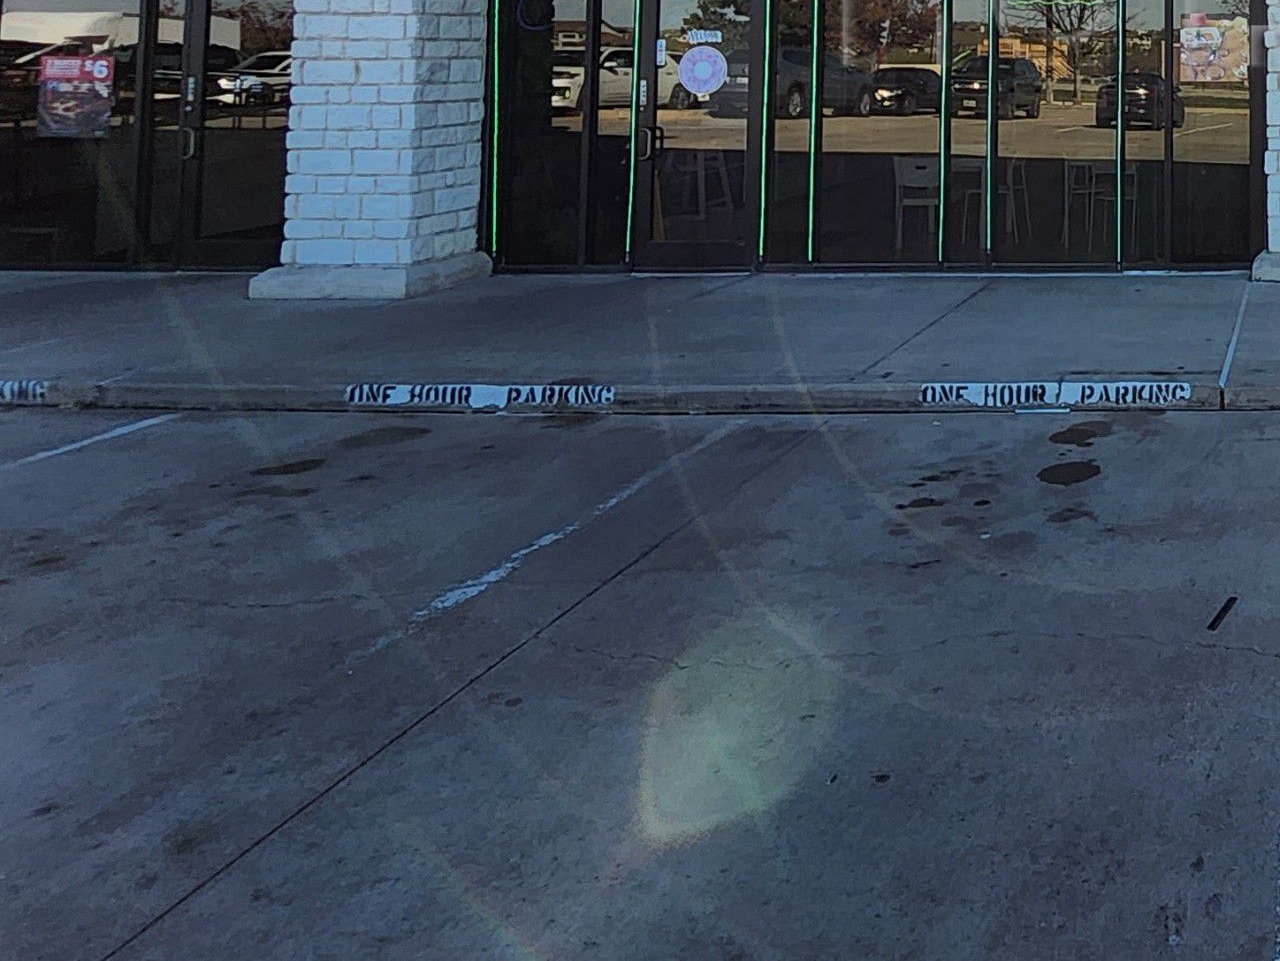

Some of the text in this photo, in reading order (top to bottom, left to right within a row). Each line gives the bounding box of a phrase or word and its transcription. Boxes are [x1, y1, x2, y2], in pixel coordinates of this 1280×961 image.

[507, 386, 614, 405] PARKING
[922, 384, 1188, 406] ONE HOUR PARKING
